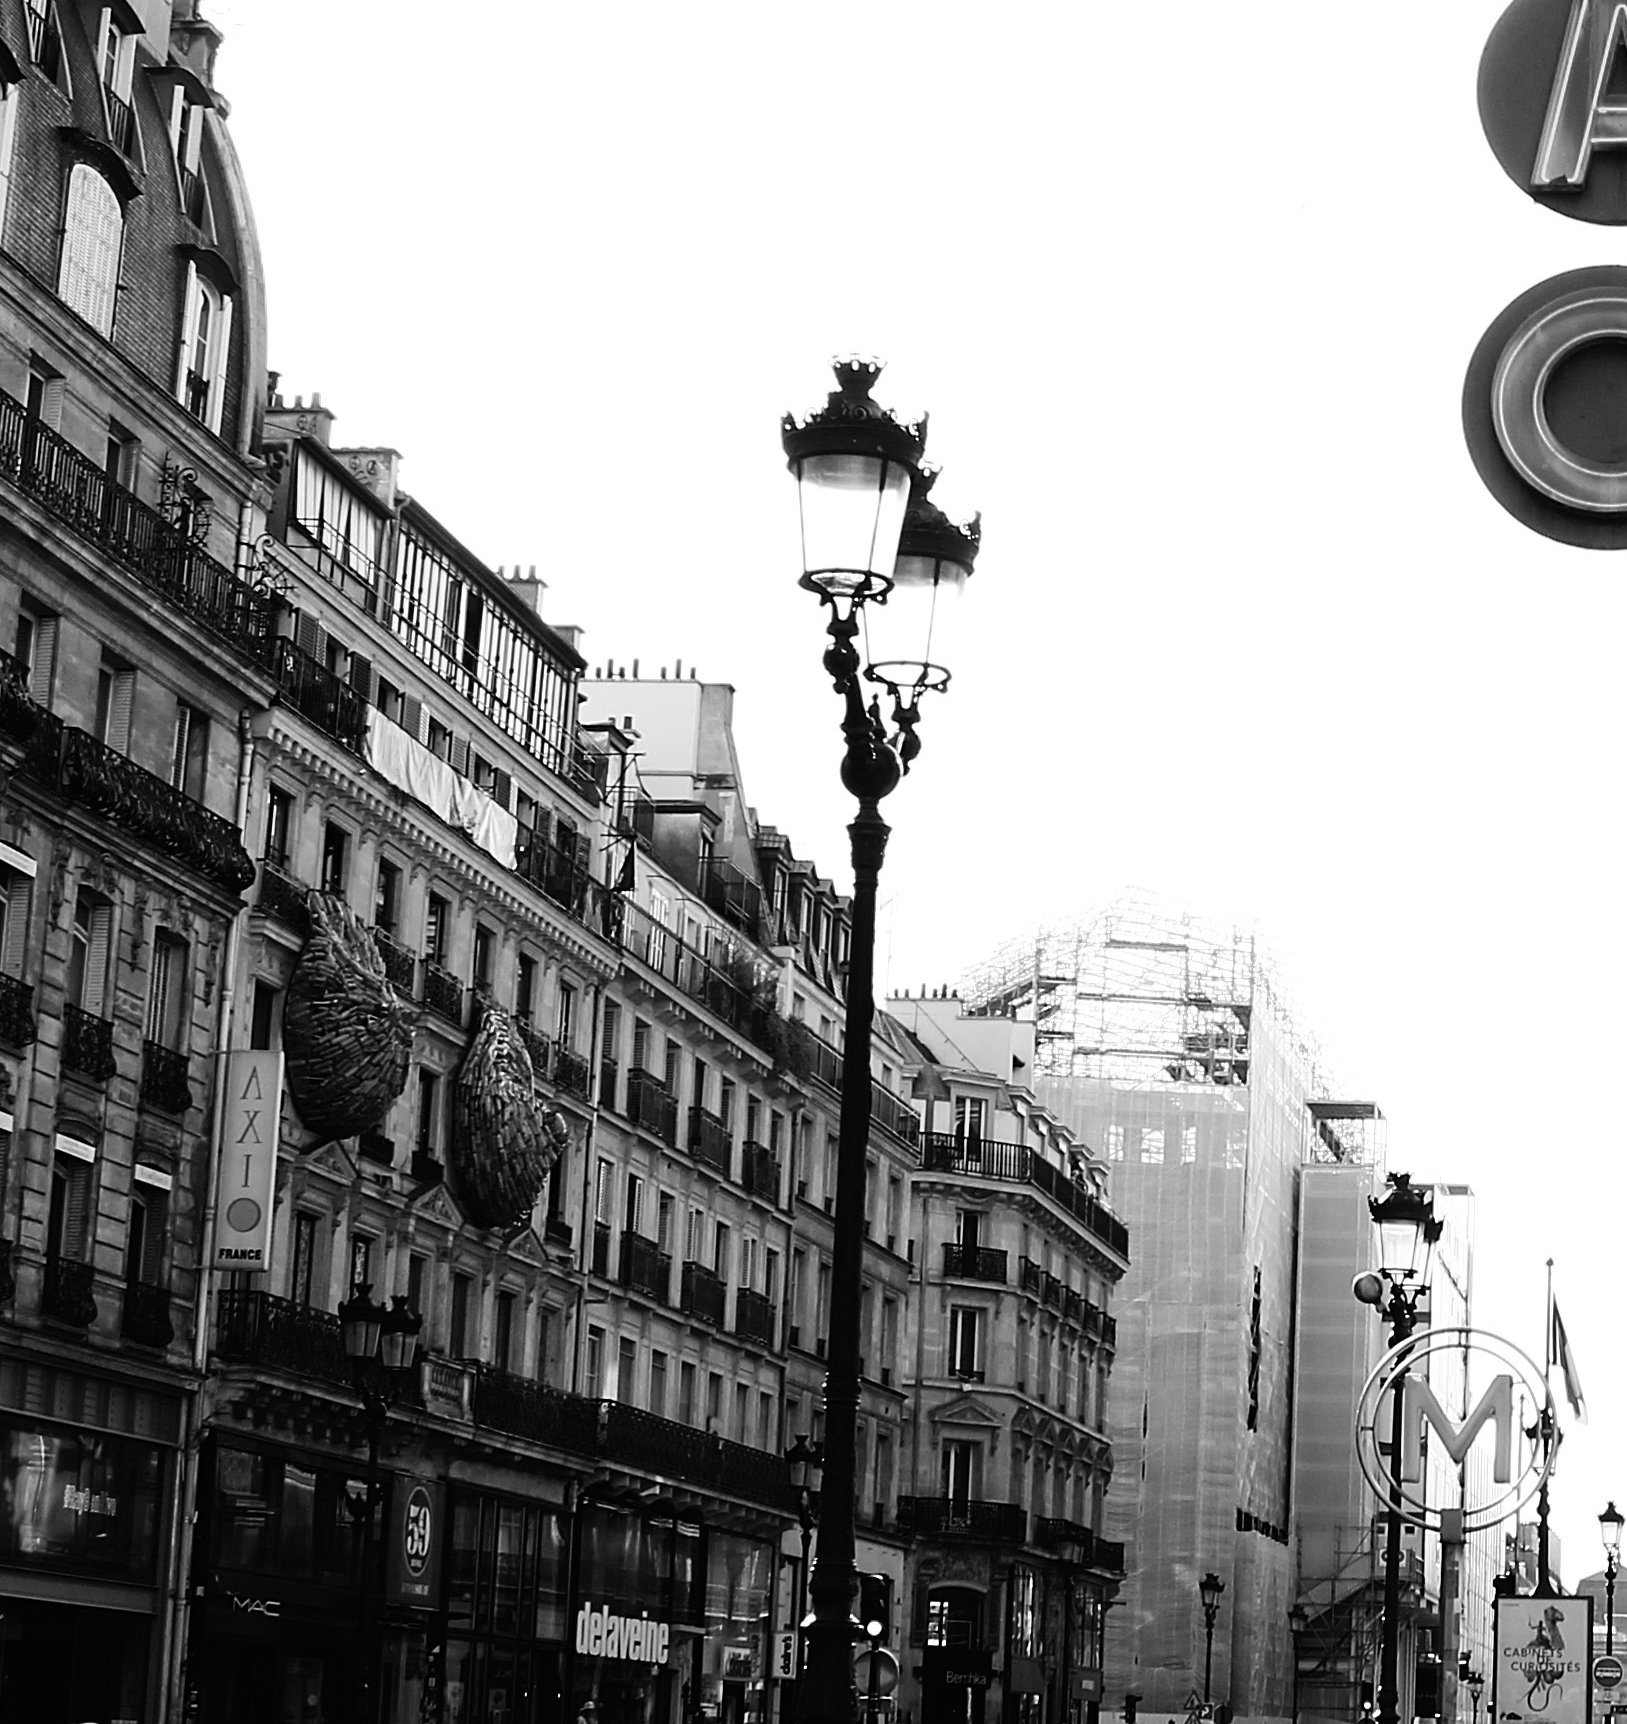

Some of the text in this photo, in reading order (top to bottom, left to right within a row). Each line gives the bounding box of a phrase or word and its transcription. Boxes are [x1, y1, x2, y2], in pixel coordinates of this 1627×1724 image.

[219, 1246, 262, 1262] FRANCE
[1401, 1374, 1512, 1483] M
[407, 1504, 431, 1557] 59
[575, 1600, 670, 1665] delaveine
[1503, 1647, 1563, 1658] CABINETS
[780, 1635, 792, 1675] claire's
[1510, 1660, 1581, 1673] CURIOSITÉS
